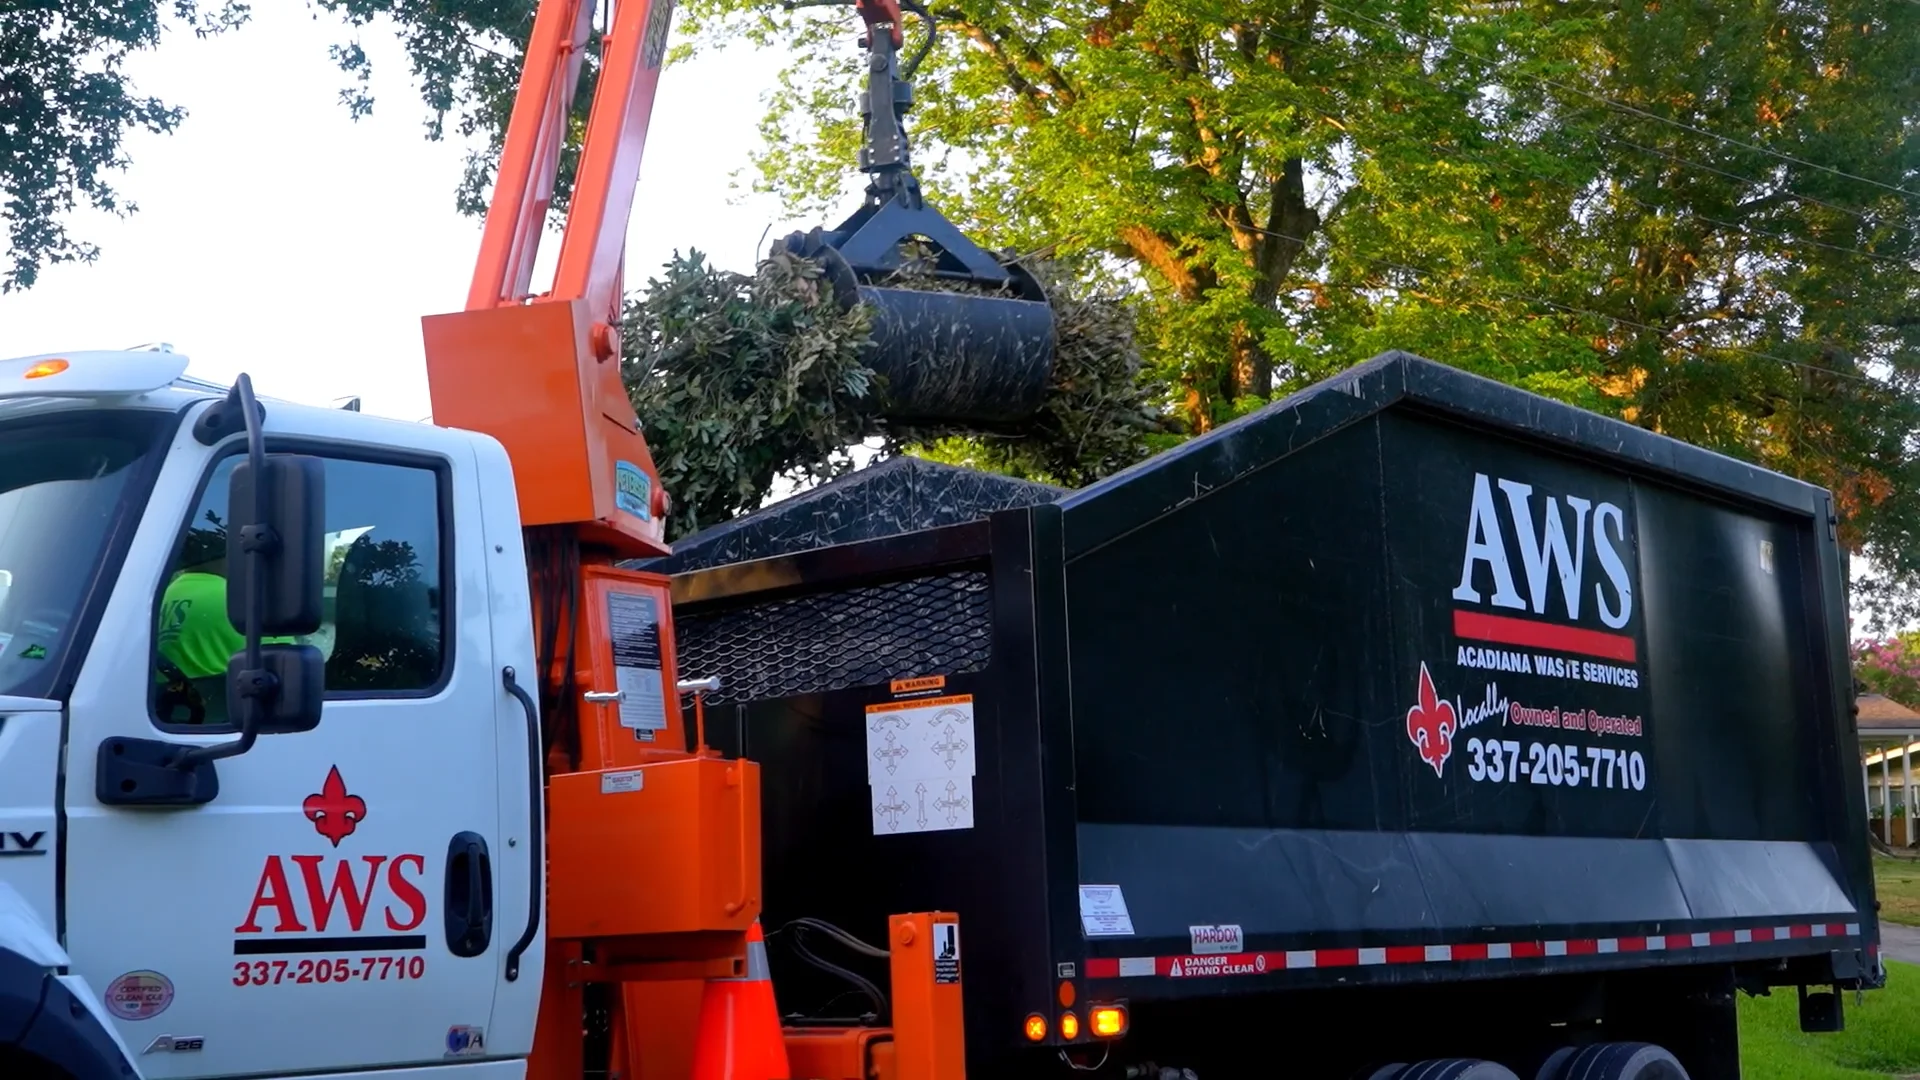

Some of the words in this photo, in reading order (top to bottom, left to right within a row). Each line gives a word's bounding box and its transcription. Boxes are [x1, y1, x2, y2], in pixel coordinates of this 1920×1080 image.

[1452, 472, 1632, 629] AWS
[904, 678, 940, 689] WARNING
[1457, 645, 1532, 674] ACADIANA
[1534, 655, 1580, 680] WASTE
[1583, 661, 1639, 689] SERVICES
[1456, 681, 1510, 730] Locally
[1510, 701, 1560, 729] Owned
[1562, 709, 1586, 731] and
[1588, 710, 1642, 737] Operated
[1466, 737, 1646, 791] 337-205-7710
[234, 853, 427, 933] AWS
[1194, 927, 1239, 944] HARDOX
[232, 955, 425, 987] 337-205-7710
[1184, 956, 1228, 967] DANGER
[1185, 966, 1220, 977] STAND
[1222, 964, 1255, 975] CLEAR
